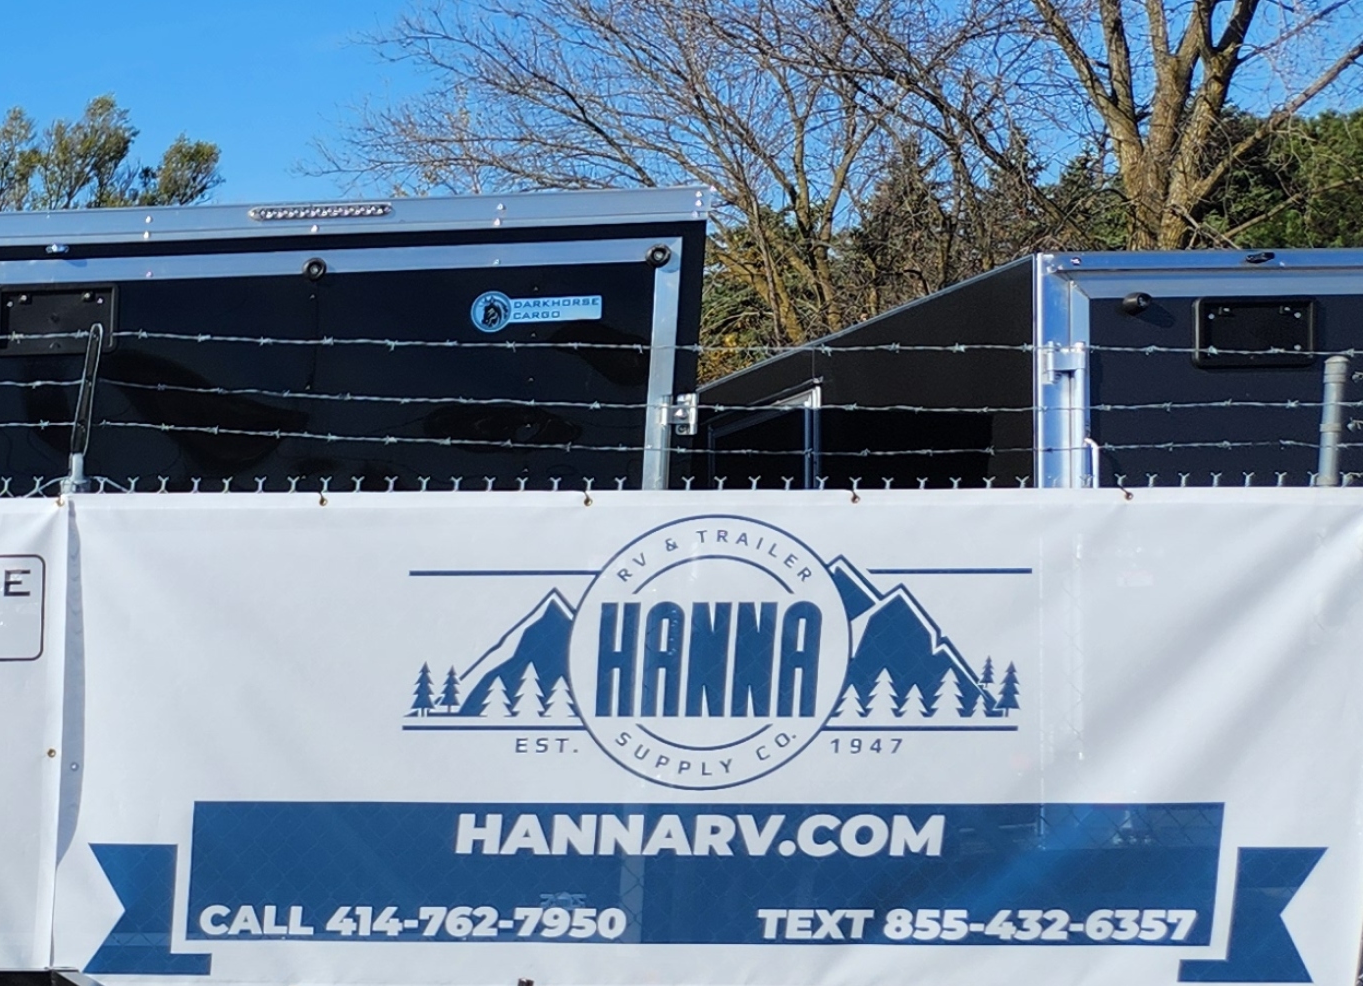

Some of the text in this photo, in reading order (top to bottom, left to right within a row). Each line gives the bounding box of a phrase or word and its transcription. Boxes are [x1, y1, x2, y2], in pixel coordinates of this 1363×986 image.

[513, 297, 600, 309] DARKHORSE
[513, 310, 561, 320] CARGO
[617, 528, 813, 583] RV & TRAILER
[594, 600, 823, 718] HANNA
[515, 738, 579, 754] EST.
[614, 731, 798, 776] SUPPLY CO.
[830, 738, 904, 754] 1947
[455, 812, 946, 857] HANNARV.COM
[199, 904, 627, 940] CALL 414-762-7950
[757, 908, 1197, 941] TEXT 855-432-6357
